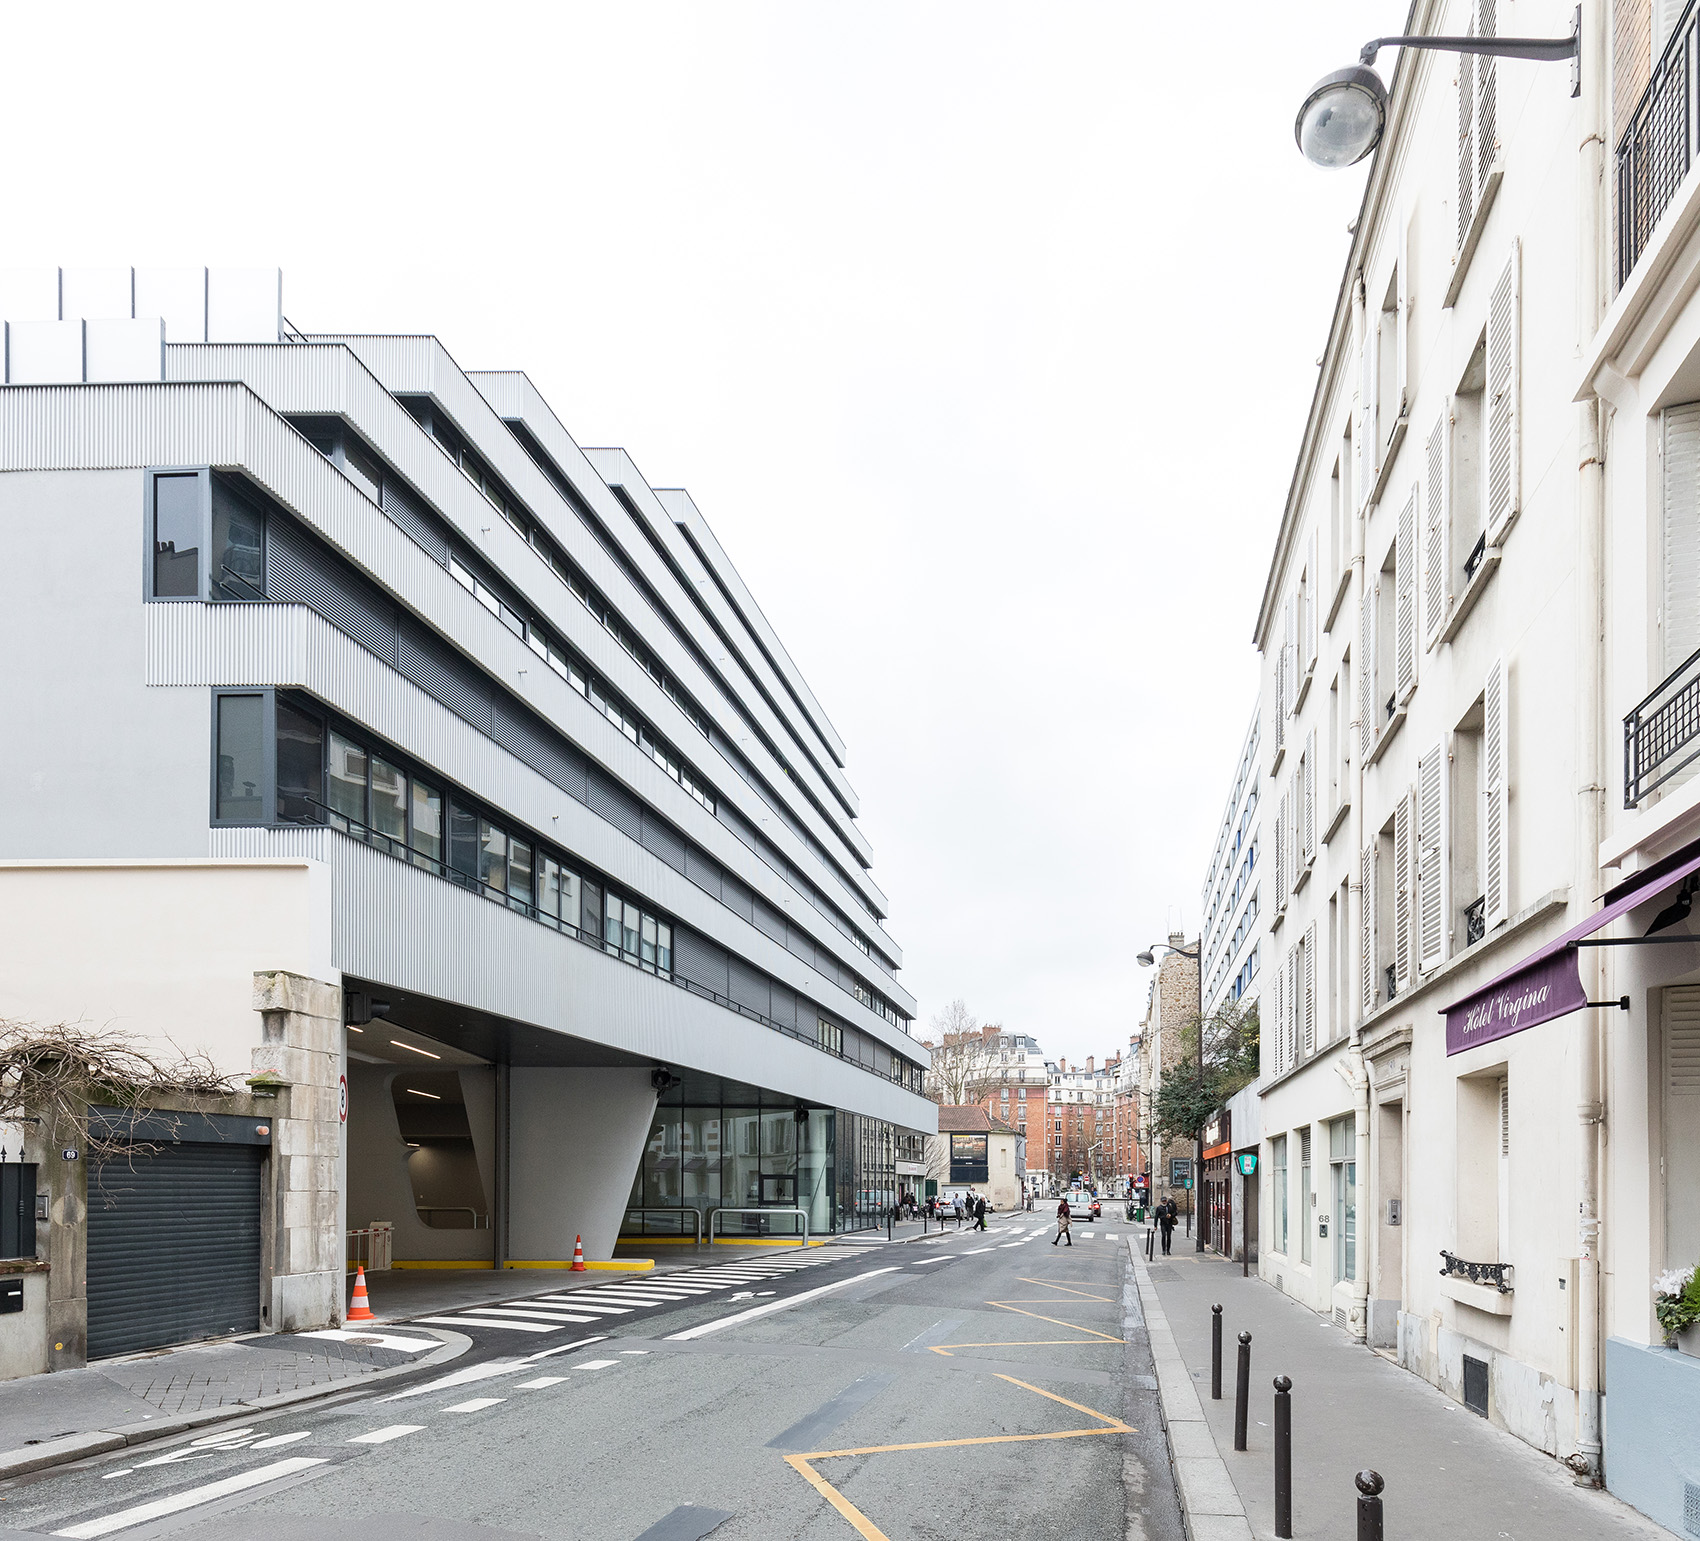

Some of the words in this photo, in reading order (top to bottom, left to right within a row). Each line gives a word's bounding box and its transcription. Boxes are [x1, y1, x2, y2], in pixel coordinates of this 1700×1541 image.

[1495, 984, 1551, 1028] Virgina
[66, 1151, 76, 1159] 69
[1318, 1214, 1330, 1223] 68
